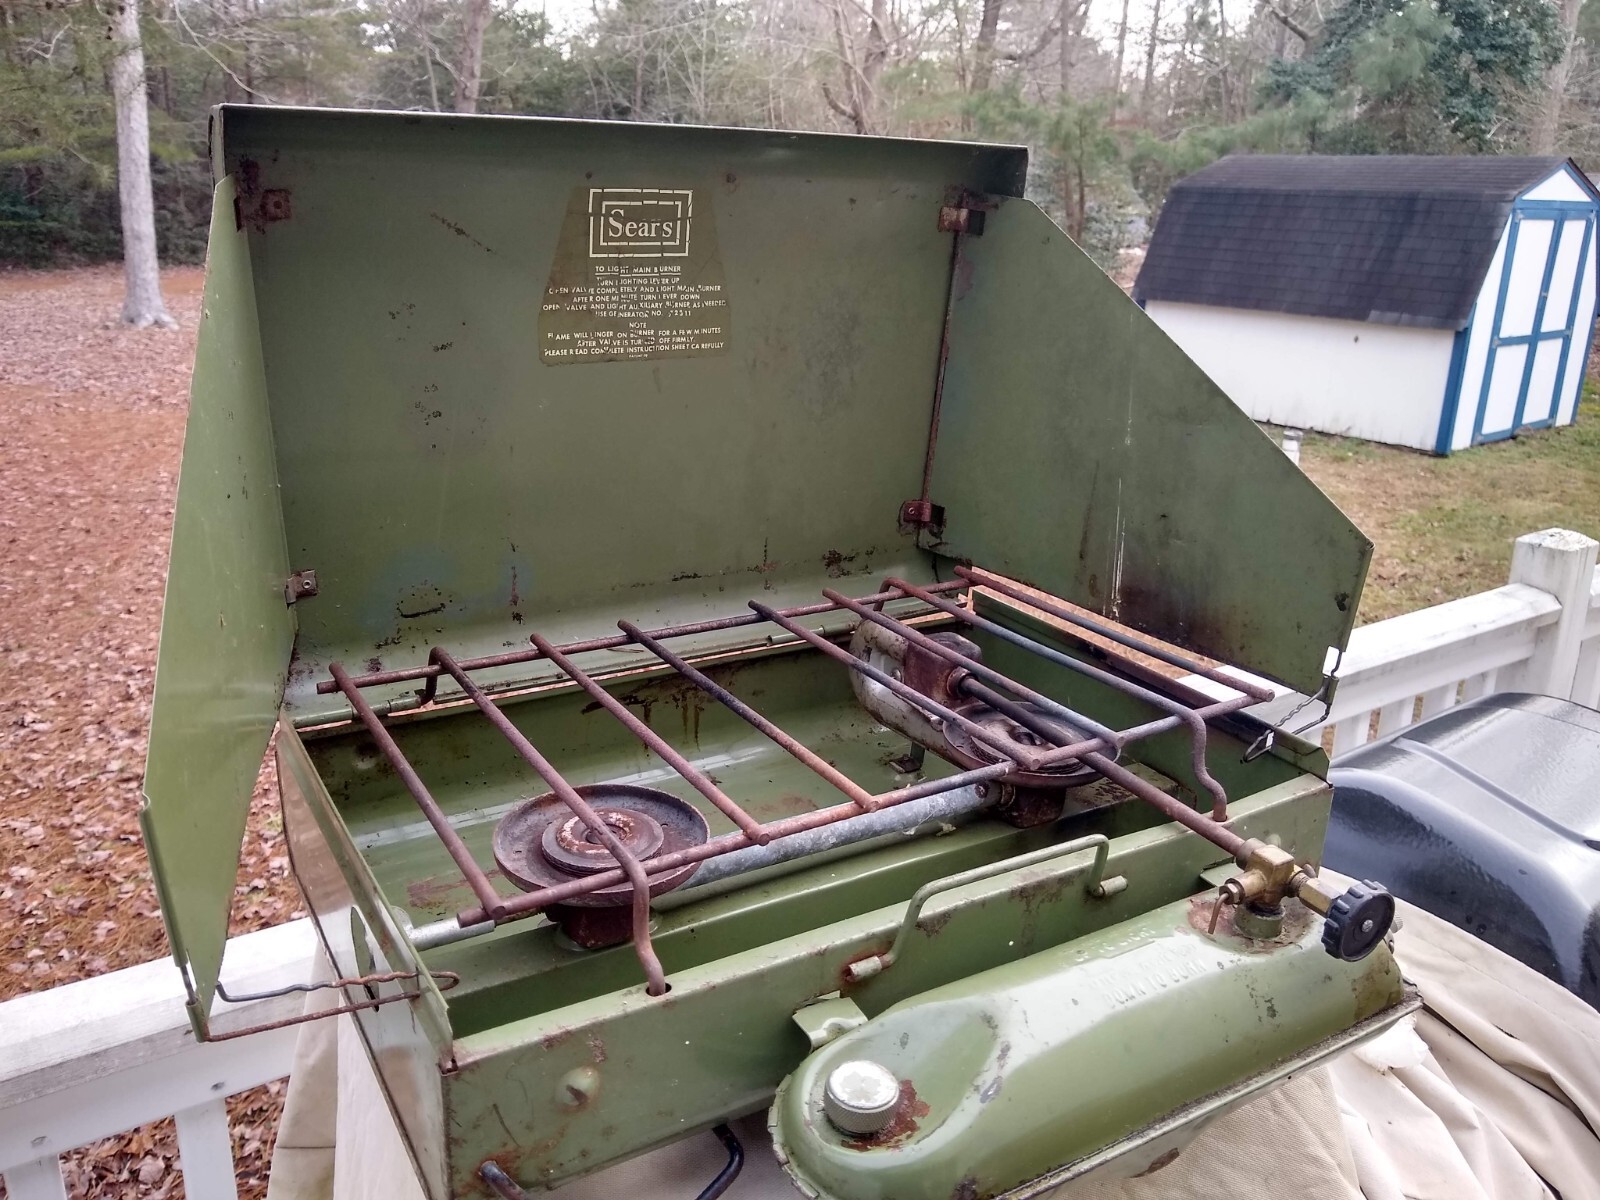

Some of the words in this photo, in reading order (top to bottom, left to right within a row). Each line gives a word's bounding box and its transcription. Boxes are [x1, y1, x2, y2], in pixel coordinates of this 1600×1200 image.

[608, 208, 673, 238] Sears
[608, 266, 630, 274] LIGHT
[654, 265, 681, 273] BURNER
[596, 277, 614, 286] TURN
[596, 286, 638, 294] COMPLETELY
[544, 348, 568, 356] PLEASE
